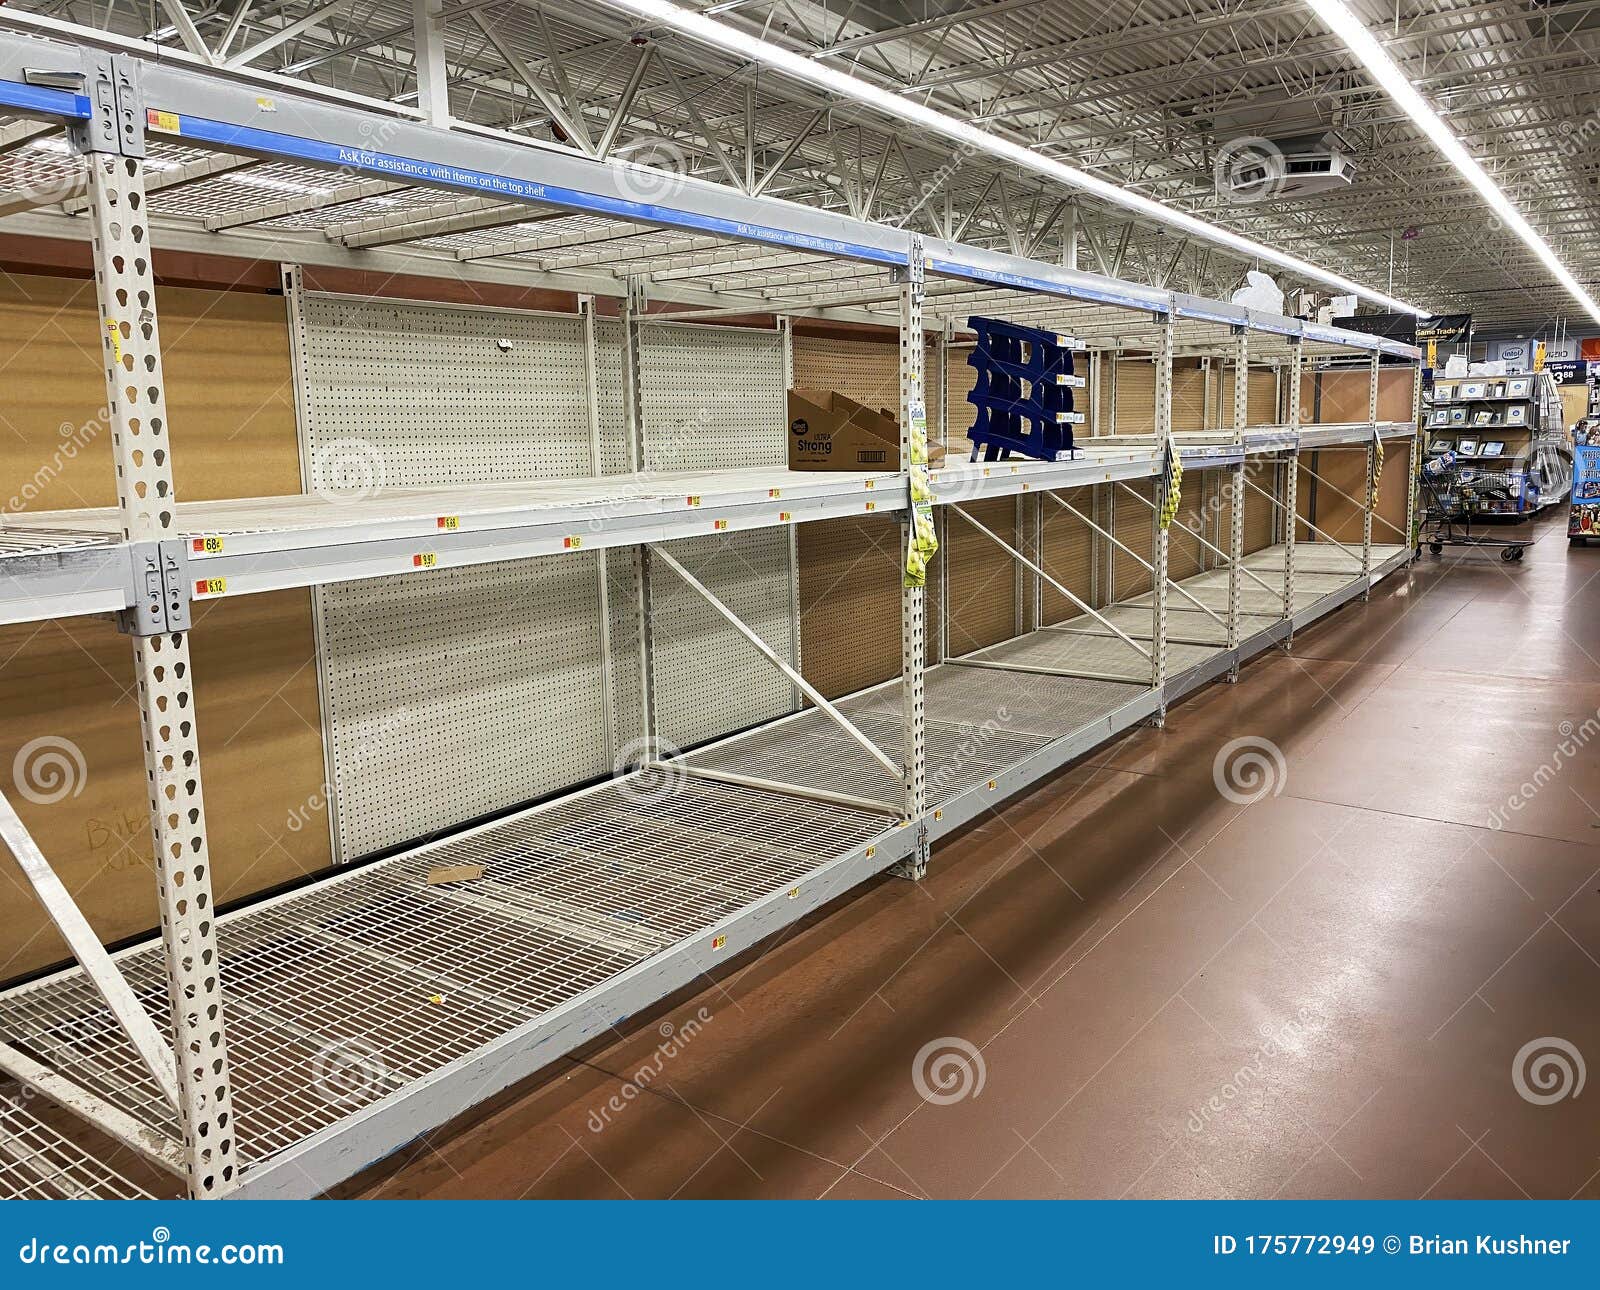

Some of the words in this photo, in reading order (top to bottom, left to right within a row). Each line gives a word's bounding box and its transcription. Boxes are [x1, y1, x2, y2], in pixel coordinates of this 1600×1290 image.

[339, 149, 359, 163] Ask
[360, 154, 376, 167] for
[377, 159, 429, 176] assistance
[430, 166, 451, 180] with
[452, 171, 478, 186] items
[479, 177, 491, 187] on
[492, 178, 508, 190] the
[508, 182, 524, 195] top
[524, 185, 546, 198] shelf.
[1415, 329, 1436, 337] Game
[797, 439, 832, 454] Strong
[209, 579, 223, 593] 6.12
